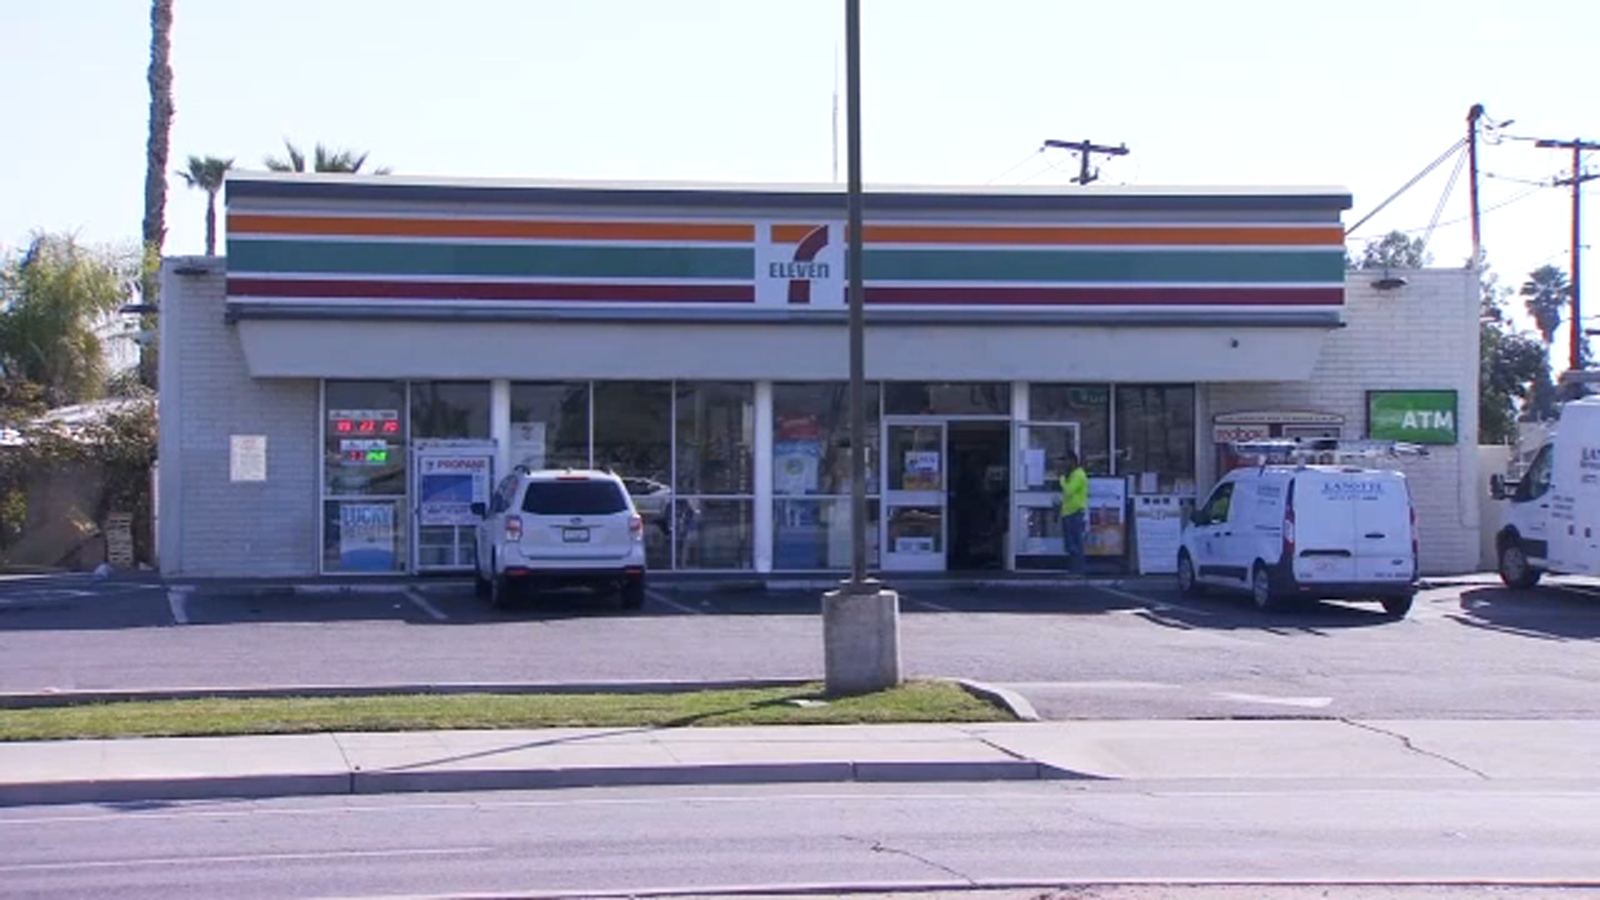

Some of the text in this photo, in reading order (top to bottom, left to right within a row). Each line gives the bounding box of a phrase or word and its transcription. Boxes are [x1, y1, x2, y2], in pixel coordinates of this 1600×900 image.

[770, 224, 829, 304] 7
[1402, 410, 1454, 429] ATM
[1216, 427, 1263, 440] redbox
